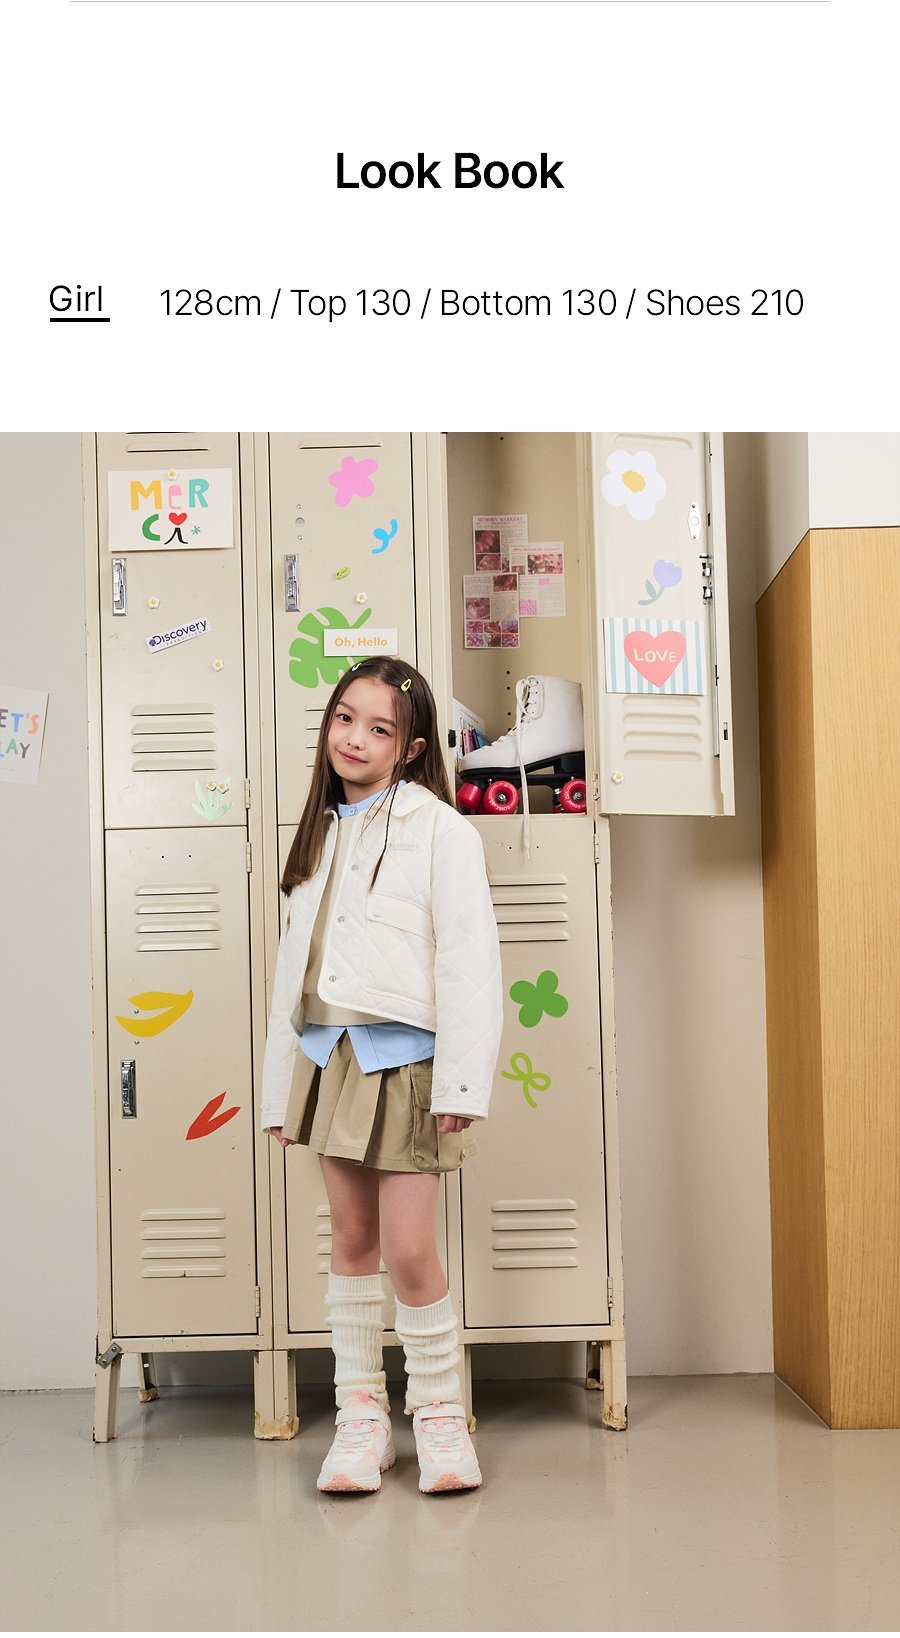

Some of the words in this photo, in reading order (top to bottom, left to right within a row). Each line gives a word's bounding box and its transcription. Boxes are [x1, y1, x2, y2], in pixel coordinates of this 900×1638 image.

[149, 620, 206, 646] Discovery
[334, 636, 355, 649] Oh,
[357, 636, 389, 647] Hello
[633, 647, 677, 664] LOVE
[0, 738, 31, 759] AY
